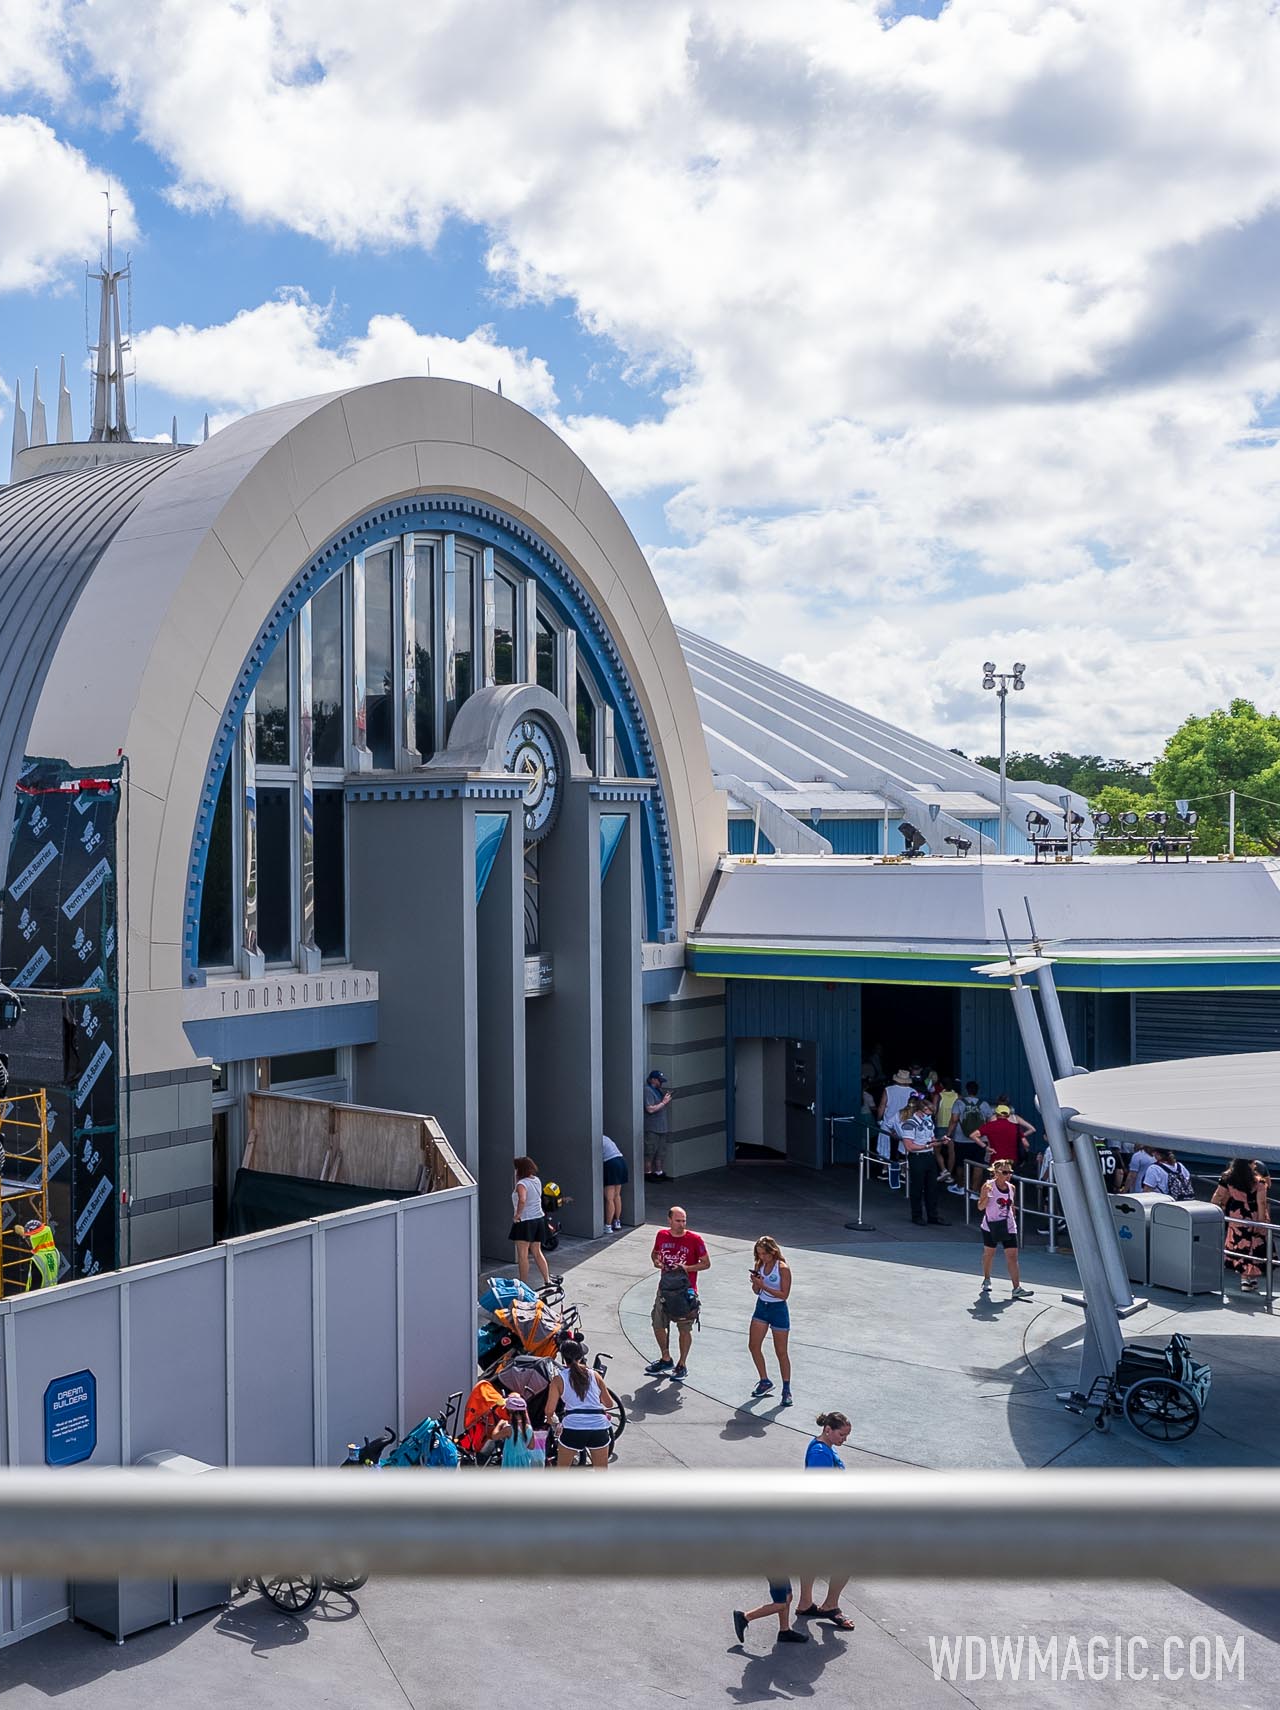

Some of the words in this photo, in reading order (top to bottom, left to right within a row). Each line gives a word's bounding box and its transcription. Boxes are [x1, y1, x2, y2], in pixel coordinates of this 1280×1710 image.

[32, 816, 48, 836] gcp
[85, 832, 101, 853] gcp
[12, 849, 51, 894] Perm-A-Barrier
[66, 866, 106, 912] Perm-A-Barrier
[22, 920, 37, 940] gcp
[78, 940, 93, 960] gcp
[221, 978, 371, 1011] TOMORROWLAND
[85, 1016, 99, 1037] gcp
[86, 1151, 100, 1173] gcp
[1101, 1156, 1116, 1175] 19
[53, 1393, 88, 1410] BUILDERS
[57, 1386, 83, 1401] DREAM
